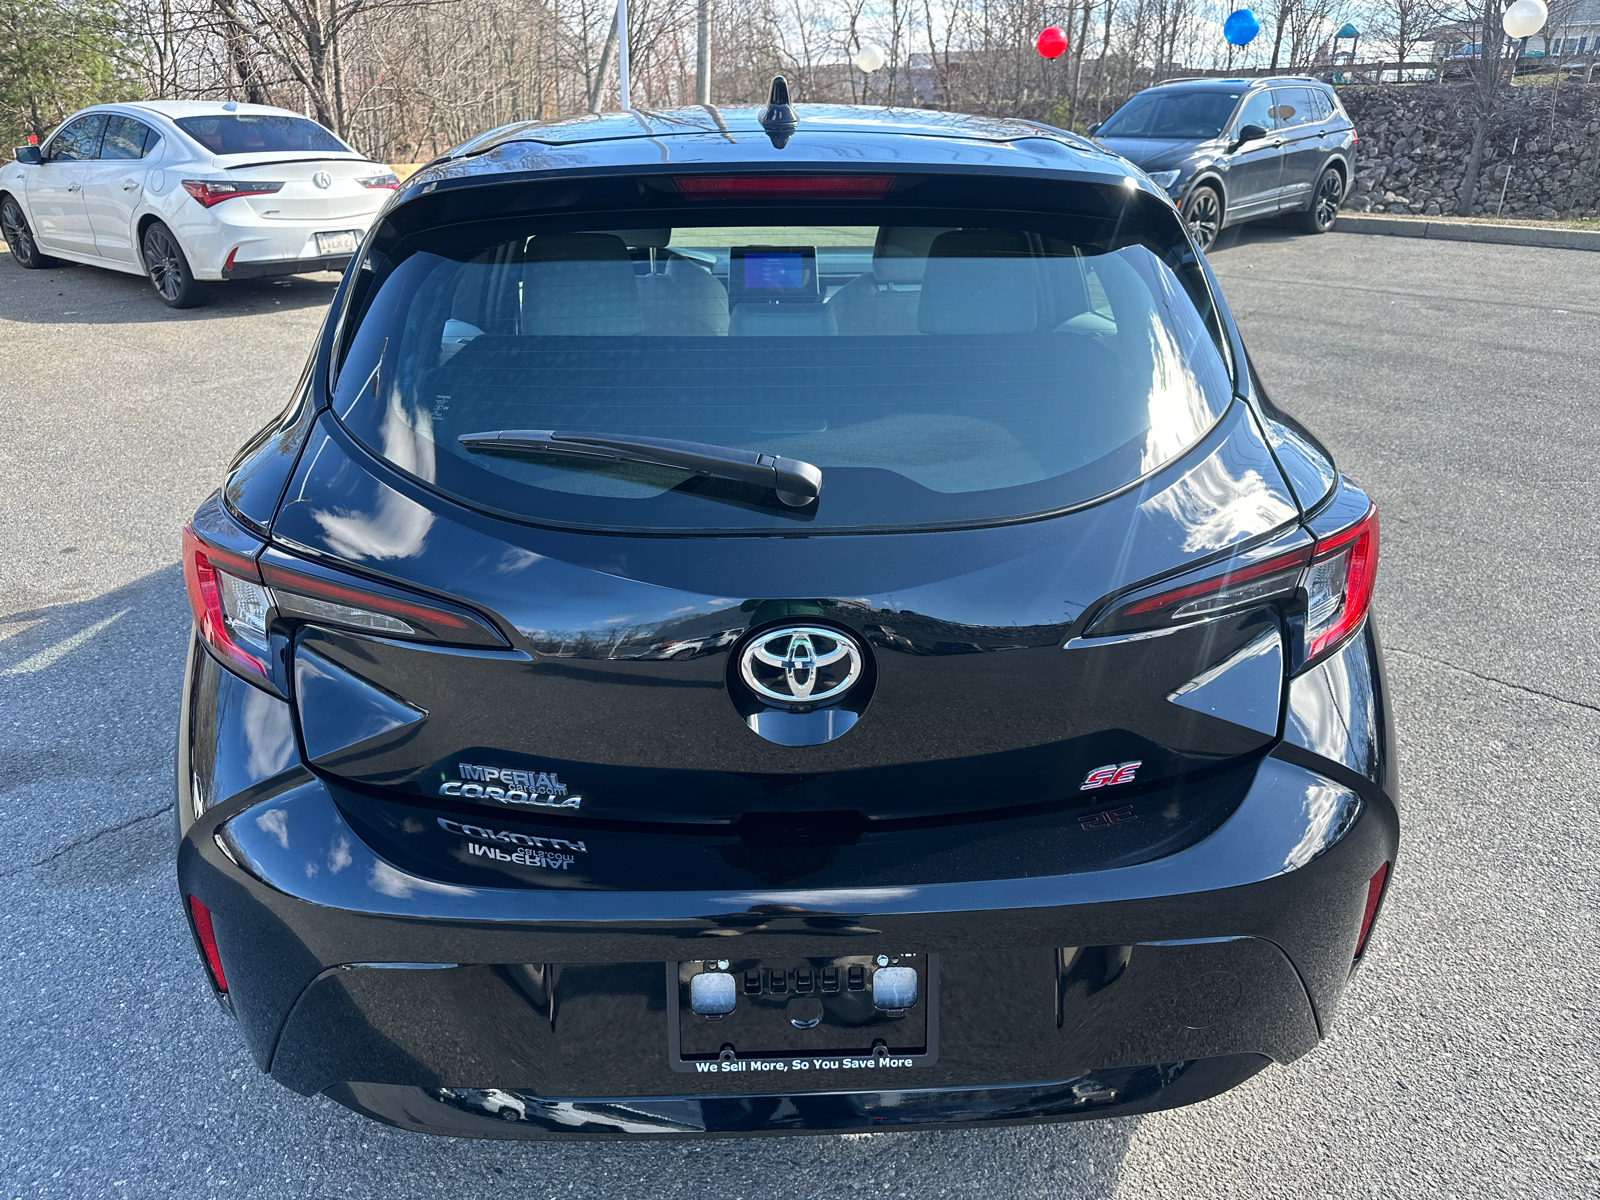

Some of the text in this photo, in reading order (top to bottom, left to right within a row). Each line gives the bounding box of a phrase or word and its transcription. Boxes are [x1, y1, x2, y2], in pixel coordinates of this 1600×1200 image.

[459, 763, 568, 790] IMPERIAL
[1080, 760, 1143, 791] SE
[439, 781, 583, 810] COROLLA
[508, 783, 568, 797] cars.com
[695, 1057, 913, 1073] We Sell More, So You Save More
